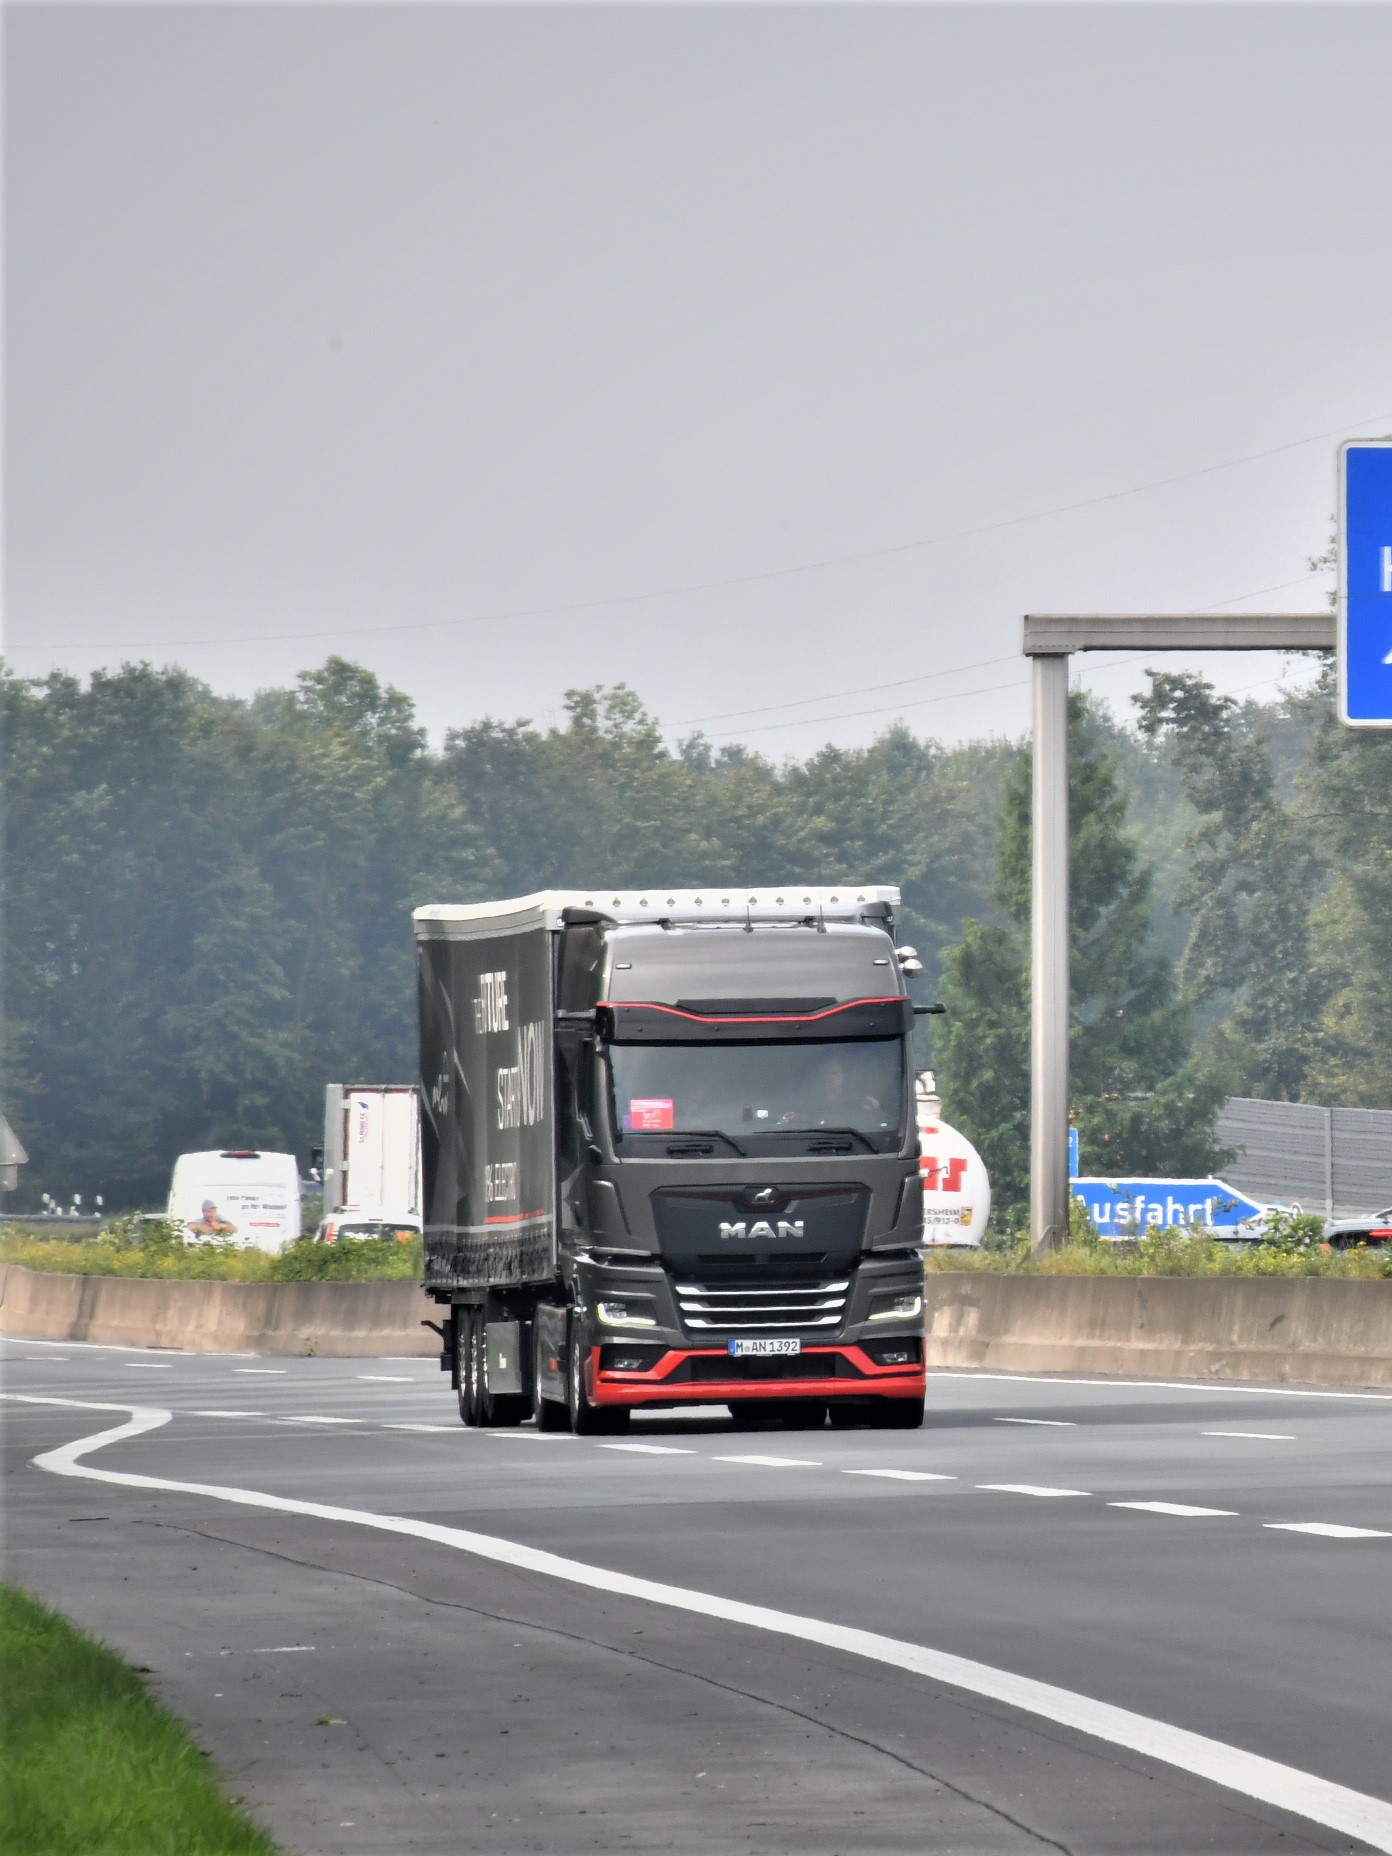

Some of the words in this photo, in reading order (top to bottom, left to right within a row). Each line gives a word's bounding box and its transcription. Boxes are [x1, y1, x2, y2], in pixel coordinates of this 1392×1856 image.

[517, 1020, 545, 1128] NOW
[719, 1220, 804, 1239] MAN
[736, 1341, 744, 1352] M
[751, 1340, 767, 1352] AN
[769, 1340, 798, 1352] 1392
